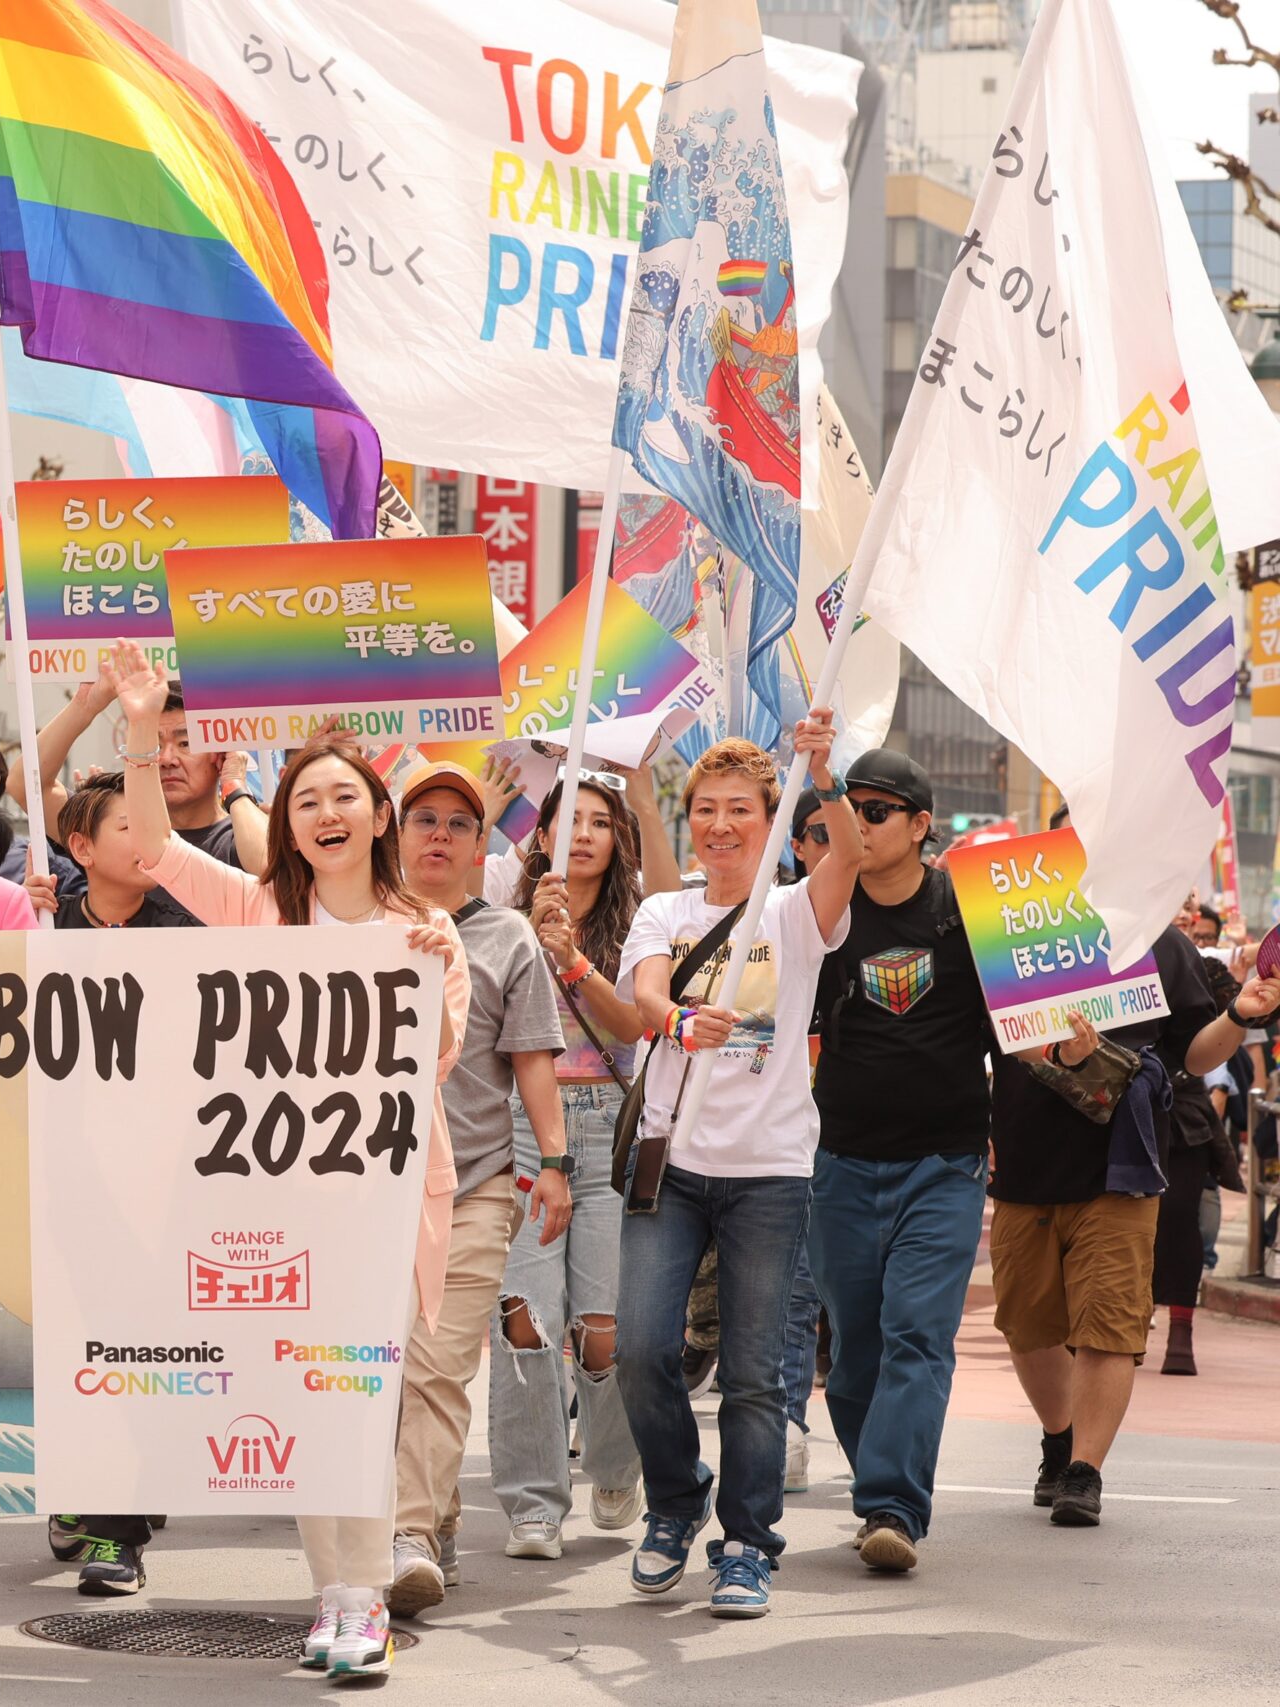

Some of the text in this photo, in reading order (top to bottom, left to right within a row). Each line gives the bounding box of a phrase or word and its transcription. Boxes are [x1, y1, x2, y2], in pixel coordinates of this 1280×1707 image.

[481, 46, 665, 166] TOK
[488, 150, 651, 242] RAINB
[480, 233, 629, 361] PRI
[63, 496, 175, 530] らしく、
[62, 539, 189, 573] たのし
[480, 476, 529, 621] 本銀
[63, 582, 161, 616] ほこら
[188, 580, 416, 623] すべての愛に
[344, 621, 476, 659] 平等を。
[28, 648, 87, 674] OKYO
[668, 675, 716, 712] IDE
[197, 715, 278, 744] TOKYO
[418, 705, 495, 734] PRIDE
[989, 852, 1064, 894] らしく、
[1000, 891, 1096, 936] たのしく、
[669, 942, 690, 961] KYO
[746, 945, 770, 963] RIDE
[1011, 928, 1111, 980] ほこらしく
[192, 967, 421, 1081] PRIDE
[999, 1009, 1047, 1043] TOKYO
[1119, 983, 1162, 1016] PRIDE
[193, 1088, 420, 1177] 2024
[211, 1231, 285, 1246] CHANGE
[227, 1249, 270, 1262] WITH
[196, 1264, 301, 1304] チェリオ
[86, 1340, 225, 1364] Panasonic
[274, 1339, 401, 1364] Panasonic
[74, 1367, 234, 1396] CONNECT
[303, 1368, 384, 1398] Group
[206, 1435, 297, 1475] ViiV
[208, 1477, 296, 1490] Healthcare
